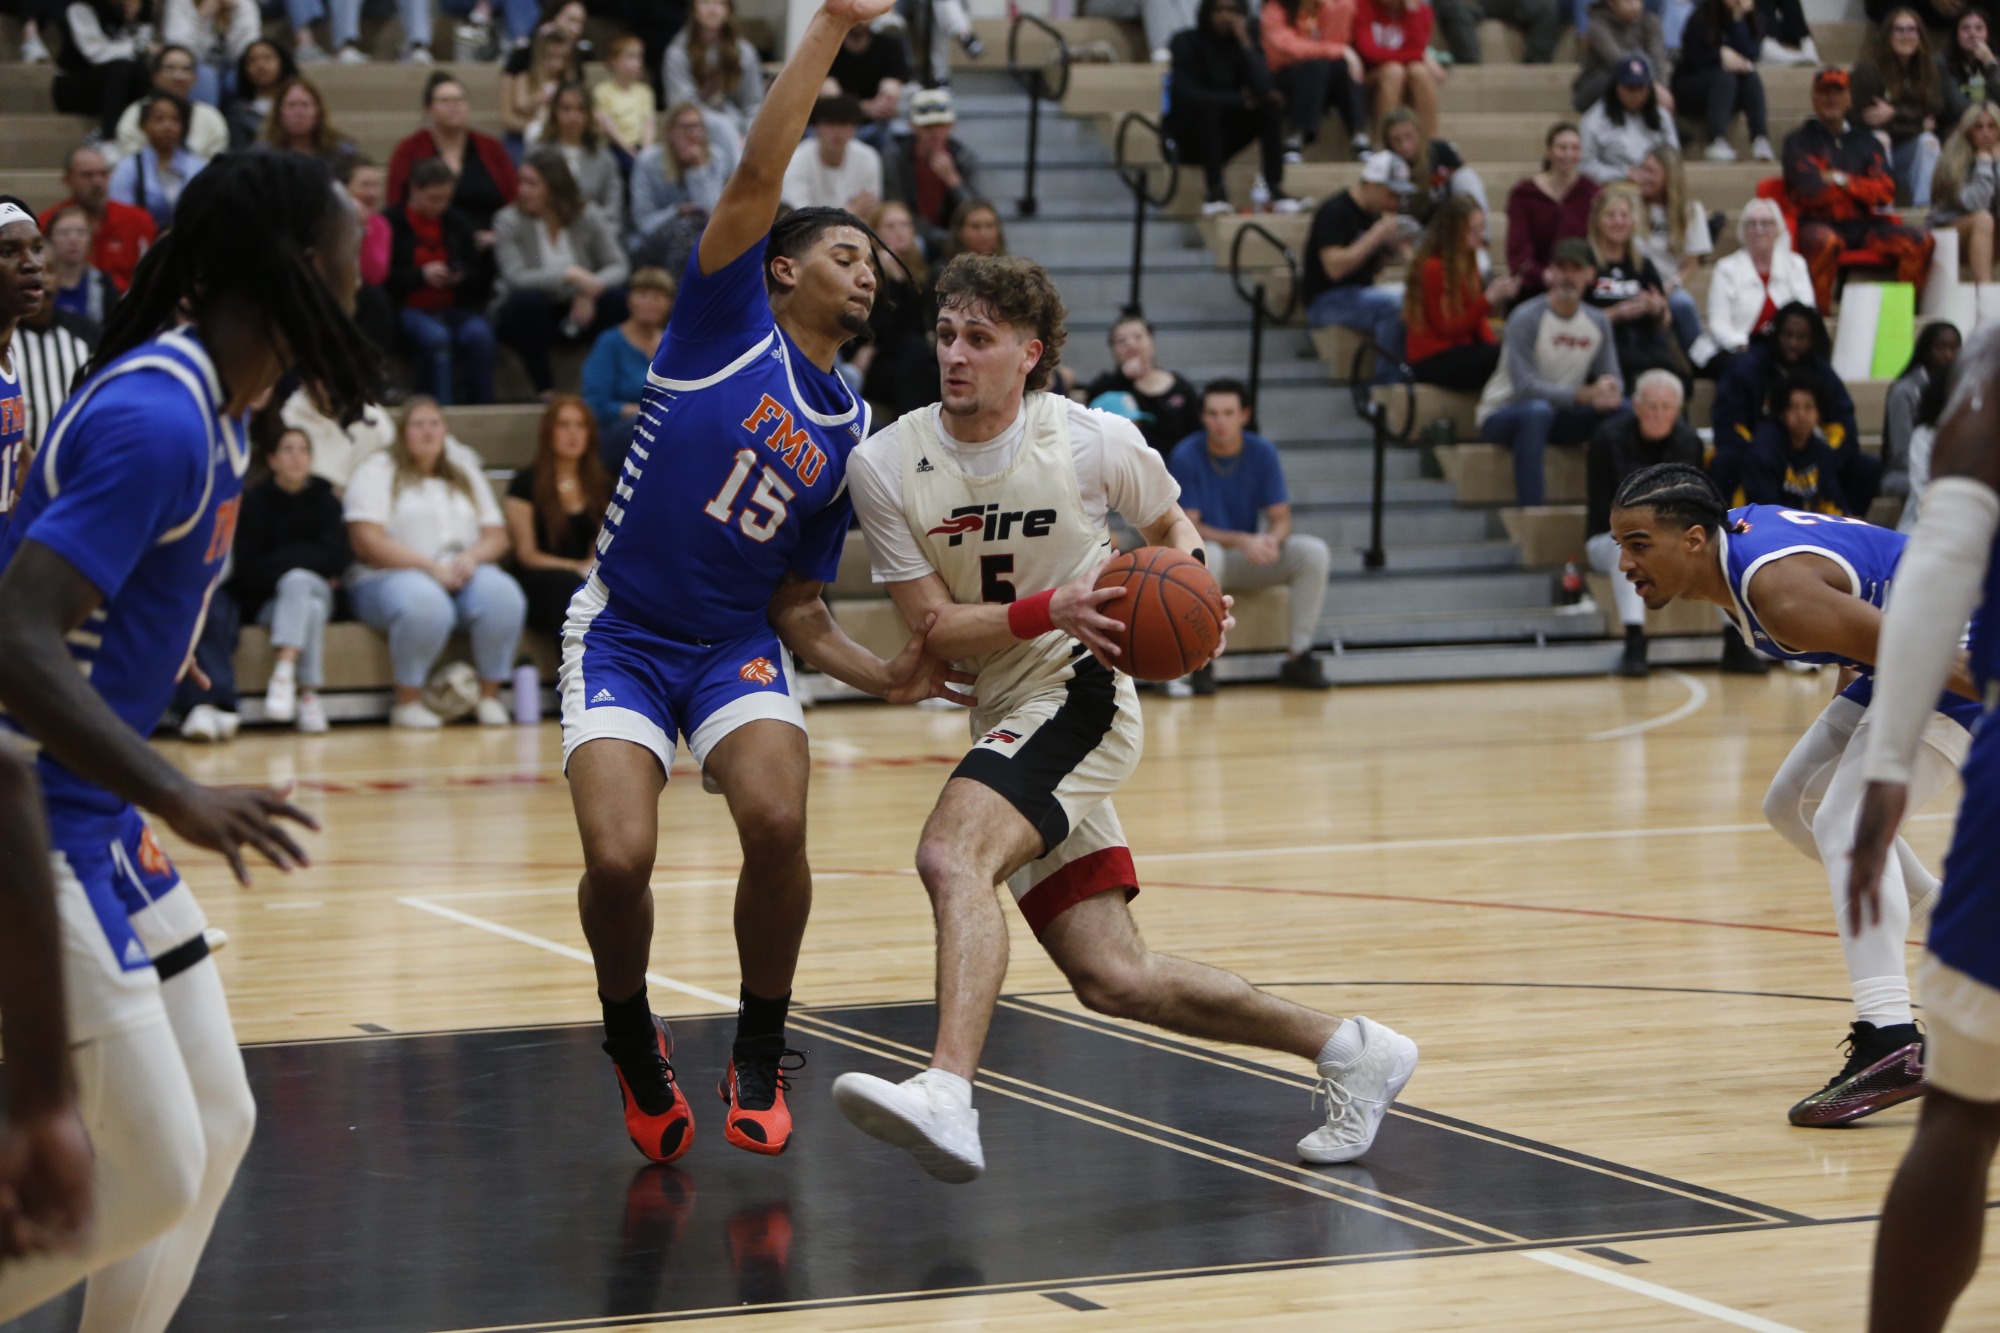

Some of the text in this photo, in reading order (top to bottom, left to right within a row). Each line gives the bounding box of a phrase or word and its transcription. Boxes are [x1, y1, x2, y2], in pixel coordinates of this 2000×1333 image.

[741, 392, 828, 487] FMU
[703, 447, 797, 543] 15
[925, 503, 1057, 547] Fire
[980, 553, 1017, 605] 5
